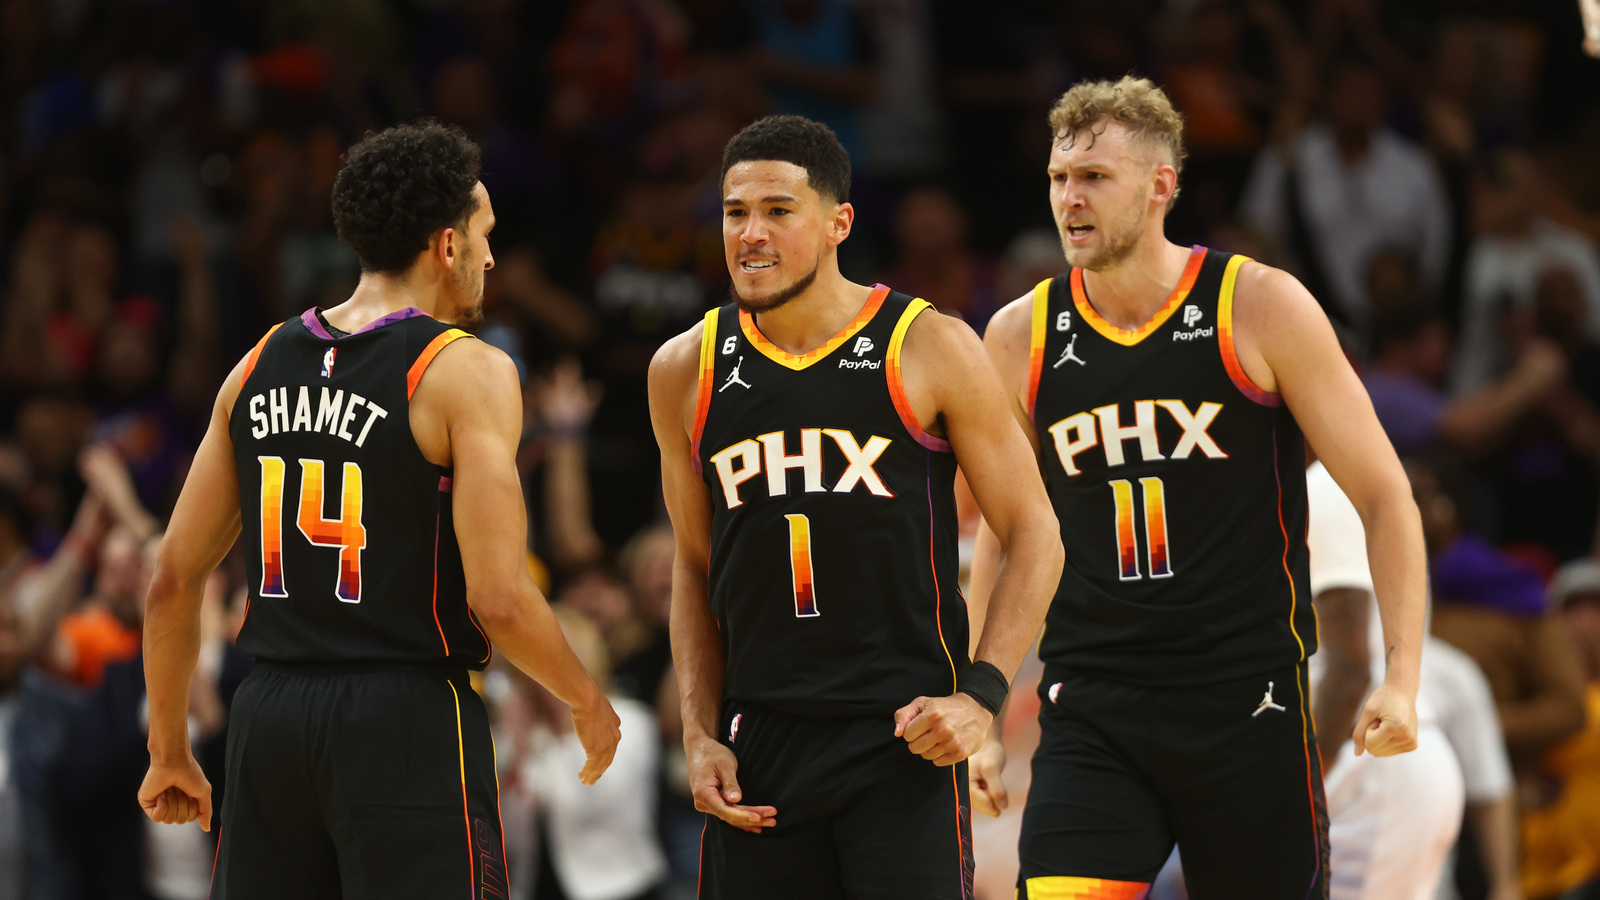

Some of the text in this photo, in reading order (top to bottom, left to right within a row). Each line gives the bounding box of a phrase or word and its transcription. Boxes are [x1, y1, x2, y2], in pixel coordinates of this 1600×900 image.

[721, 335, 738, 355] 6
[1056, 310, 1071, 331] 6
[1173, 325, 1214, 341] PayPal
[838, 358, 882, 370] PayPal
[249, 386, 388, 448] SHAMET
[1047, 399, 1230, 477] PHX
[709, 427, 896, 510] PHX
[257, 455, 367, 604] 14
[1107, 476, 1174, 581] 11
[783, 513, 821, 618] 1
